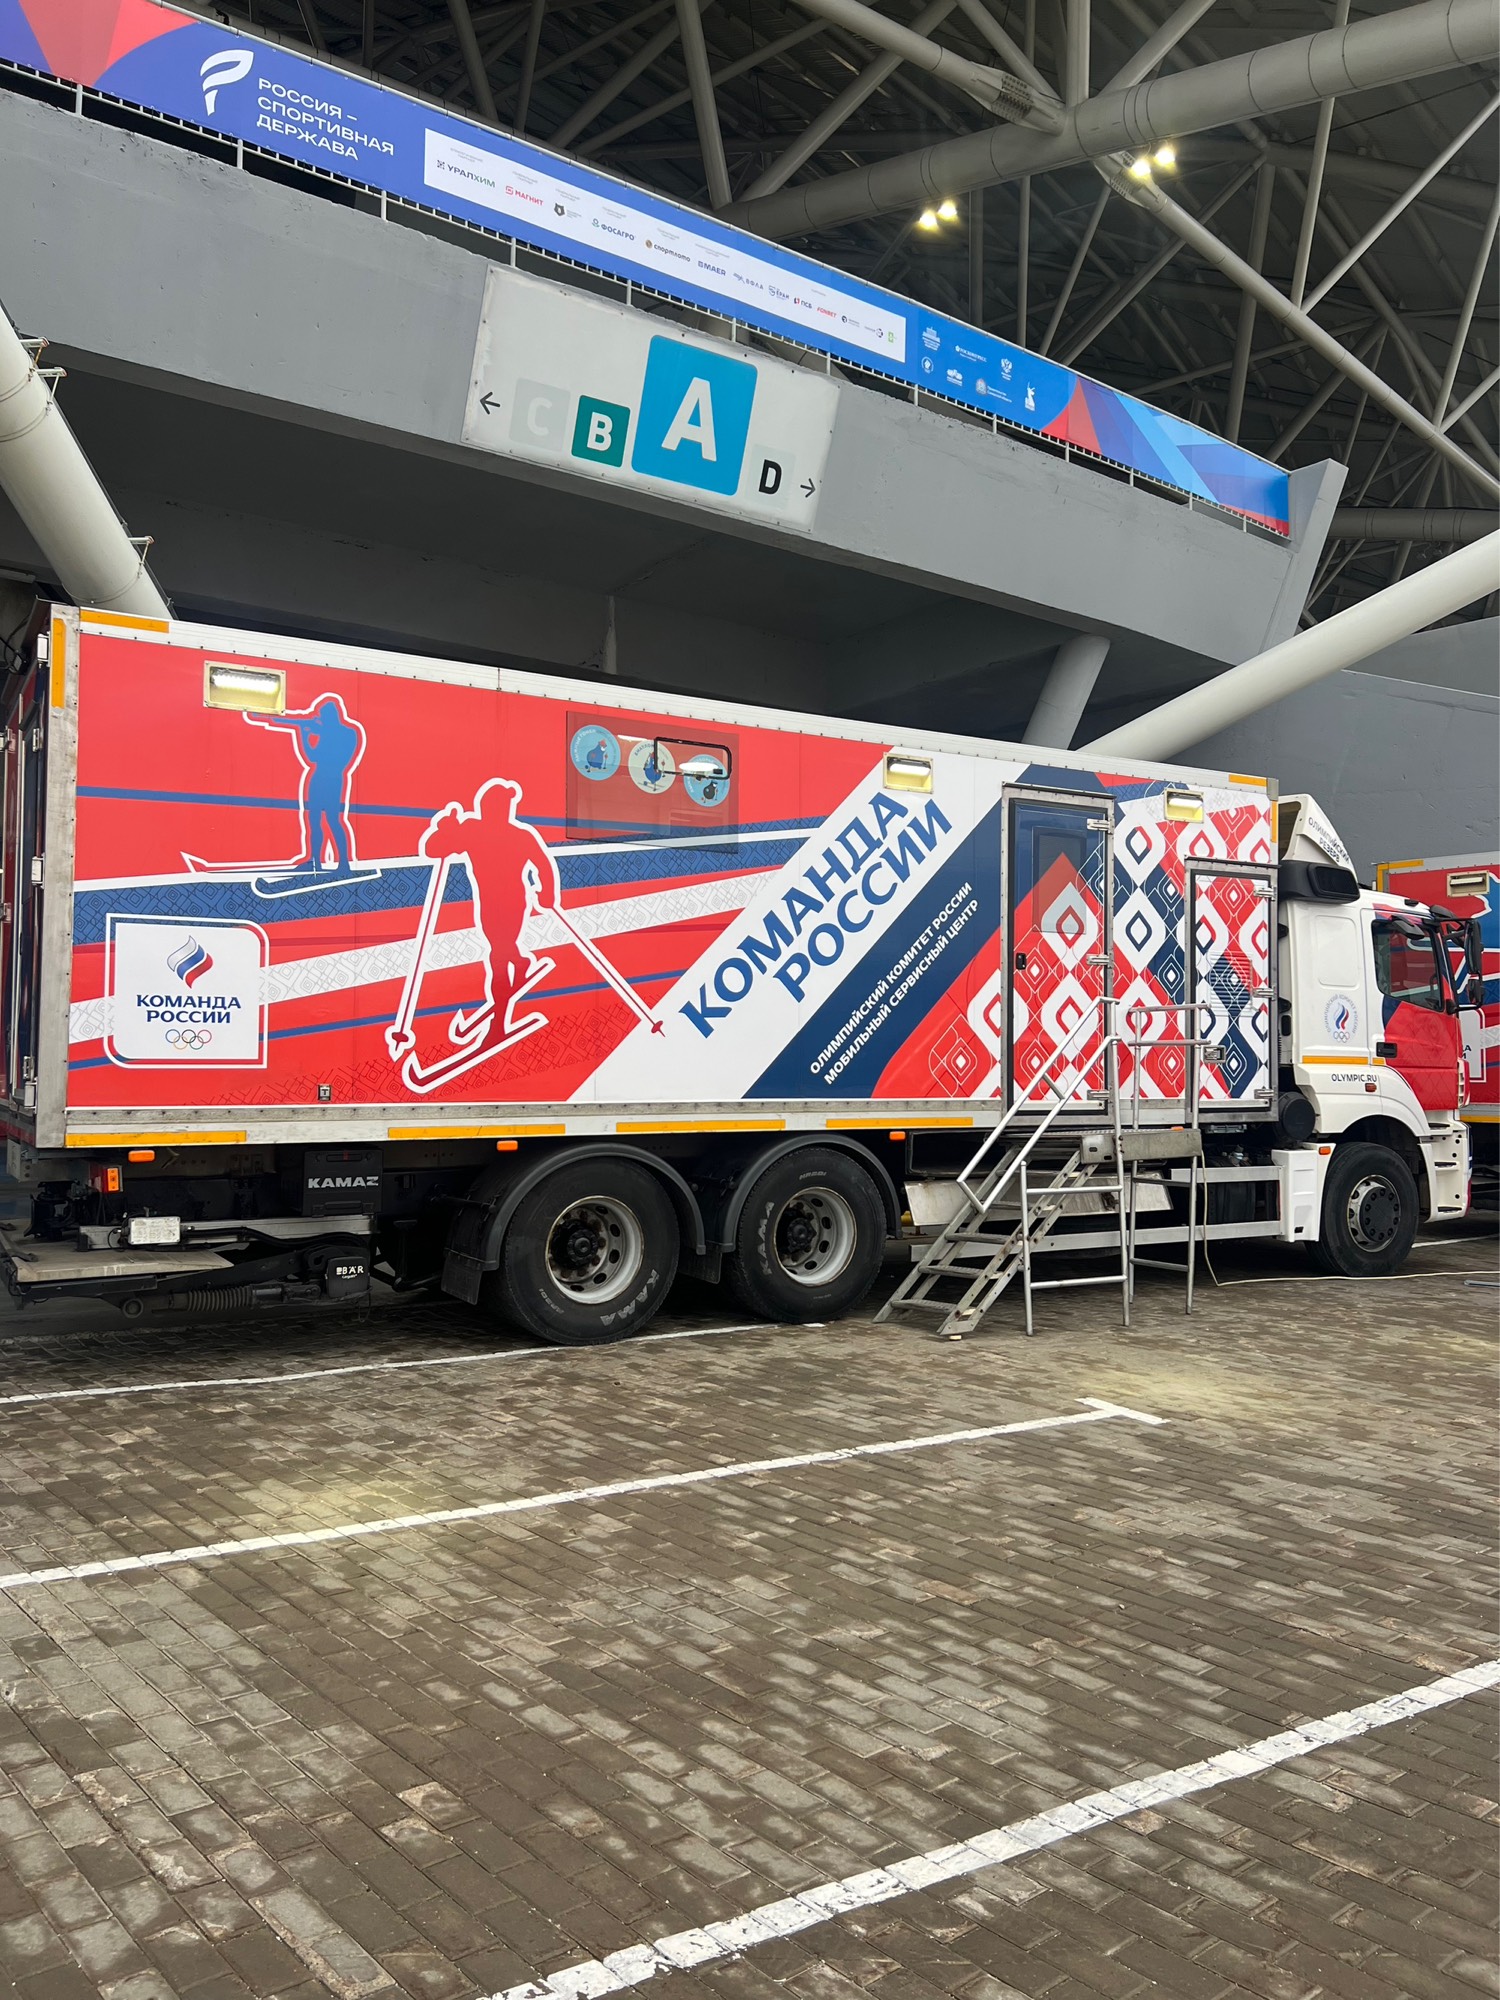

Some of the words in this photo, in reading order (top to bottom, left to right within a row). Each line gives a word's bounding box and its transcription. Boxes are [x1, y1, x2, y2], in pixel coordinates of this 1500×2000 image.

[258, 77, 342, 119] РОССИЯ
[256, 114, 359, 161] ДЕРЖАВА
[257, 96, 394, 156] СПОРТИВНАЯ
[447, 164, 496, 188] УРАЛХИМ
[515, 190, 543, 206] МАГНИТ
[601, 224, 635, 241] ФОСАГРО
[704, 262, 727, 276] MAER
[526, 397, 552, 437] C
[586, 411, 613, 452] B
[661, 376, 717, 462] A
[758, 459, 782, 495] D
[678, 792, 908, 1039] КОМАНДА
[773, 799, 953, 1003] РОССИИ
[810, 979, 890, 1075] ОЛИМПИЙСКИЙ
[886, 926, 934, 984] КОМИТЕТ
[932, 881, 973, 931] РОССИИ
[824, 1003, 892, 1085] МОБИЛЬНЫЙ
[889, 934, 949, 1007] СЕРВИСНЫЙ
[947, 899, 979, 940] ЦЕНТР
[136, 994, 242, 1010] КОМАНДА
[146, 1010, 231, 1024] РОССИИ
[1331, 1073, 1378, 1083] OLYMPIC.RU
[308, 1175, 380, 1189] KAMAZ
[757, 1201, 775, 1275] KAMA
[342, 1265, 364, 1275] BÄR
[600, 1268, 660, 1326] KAMA
